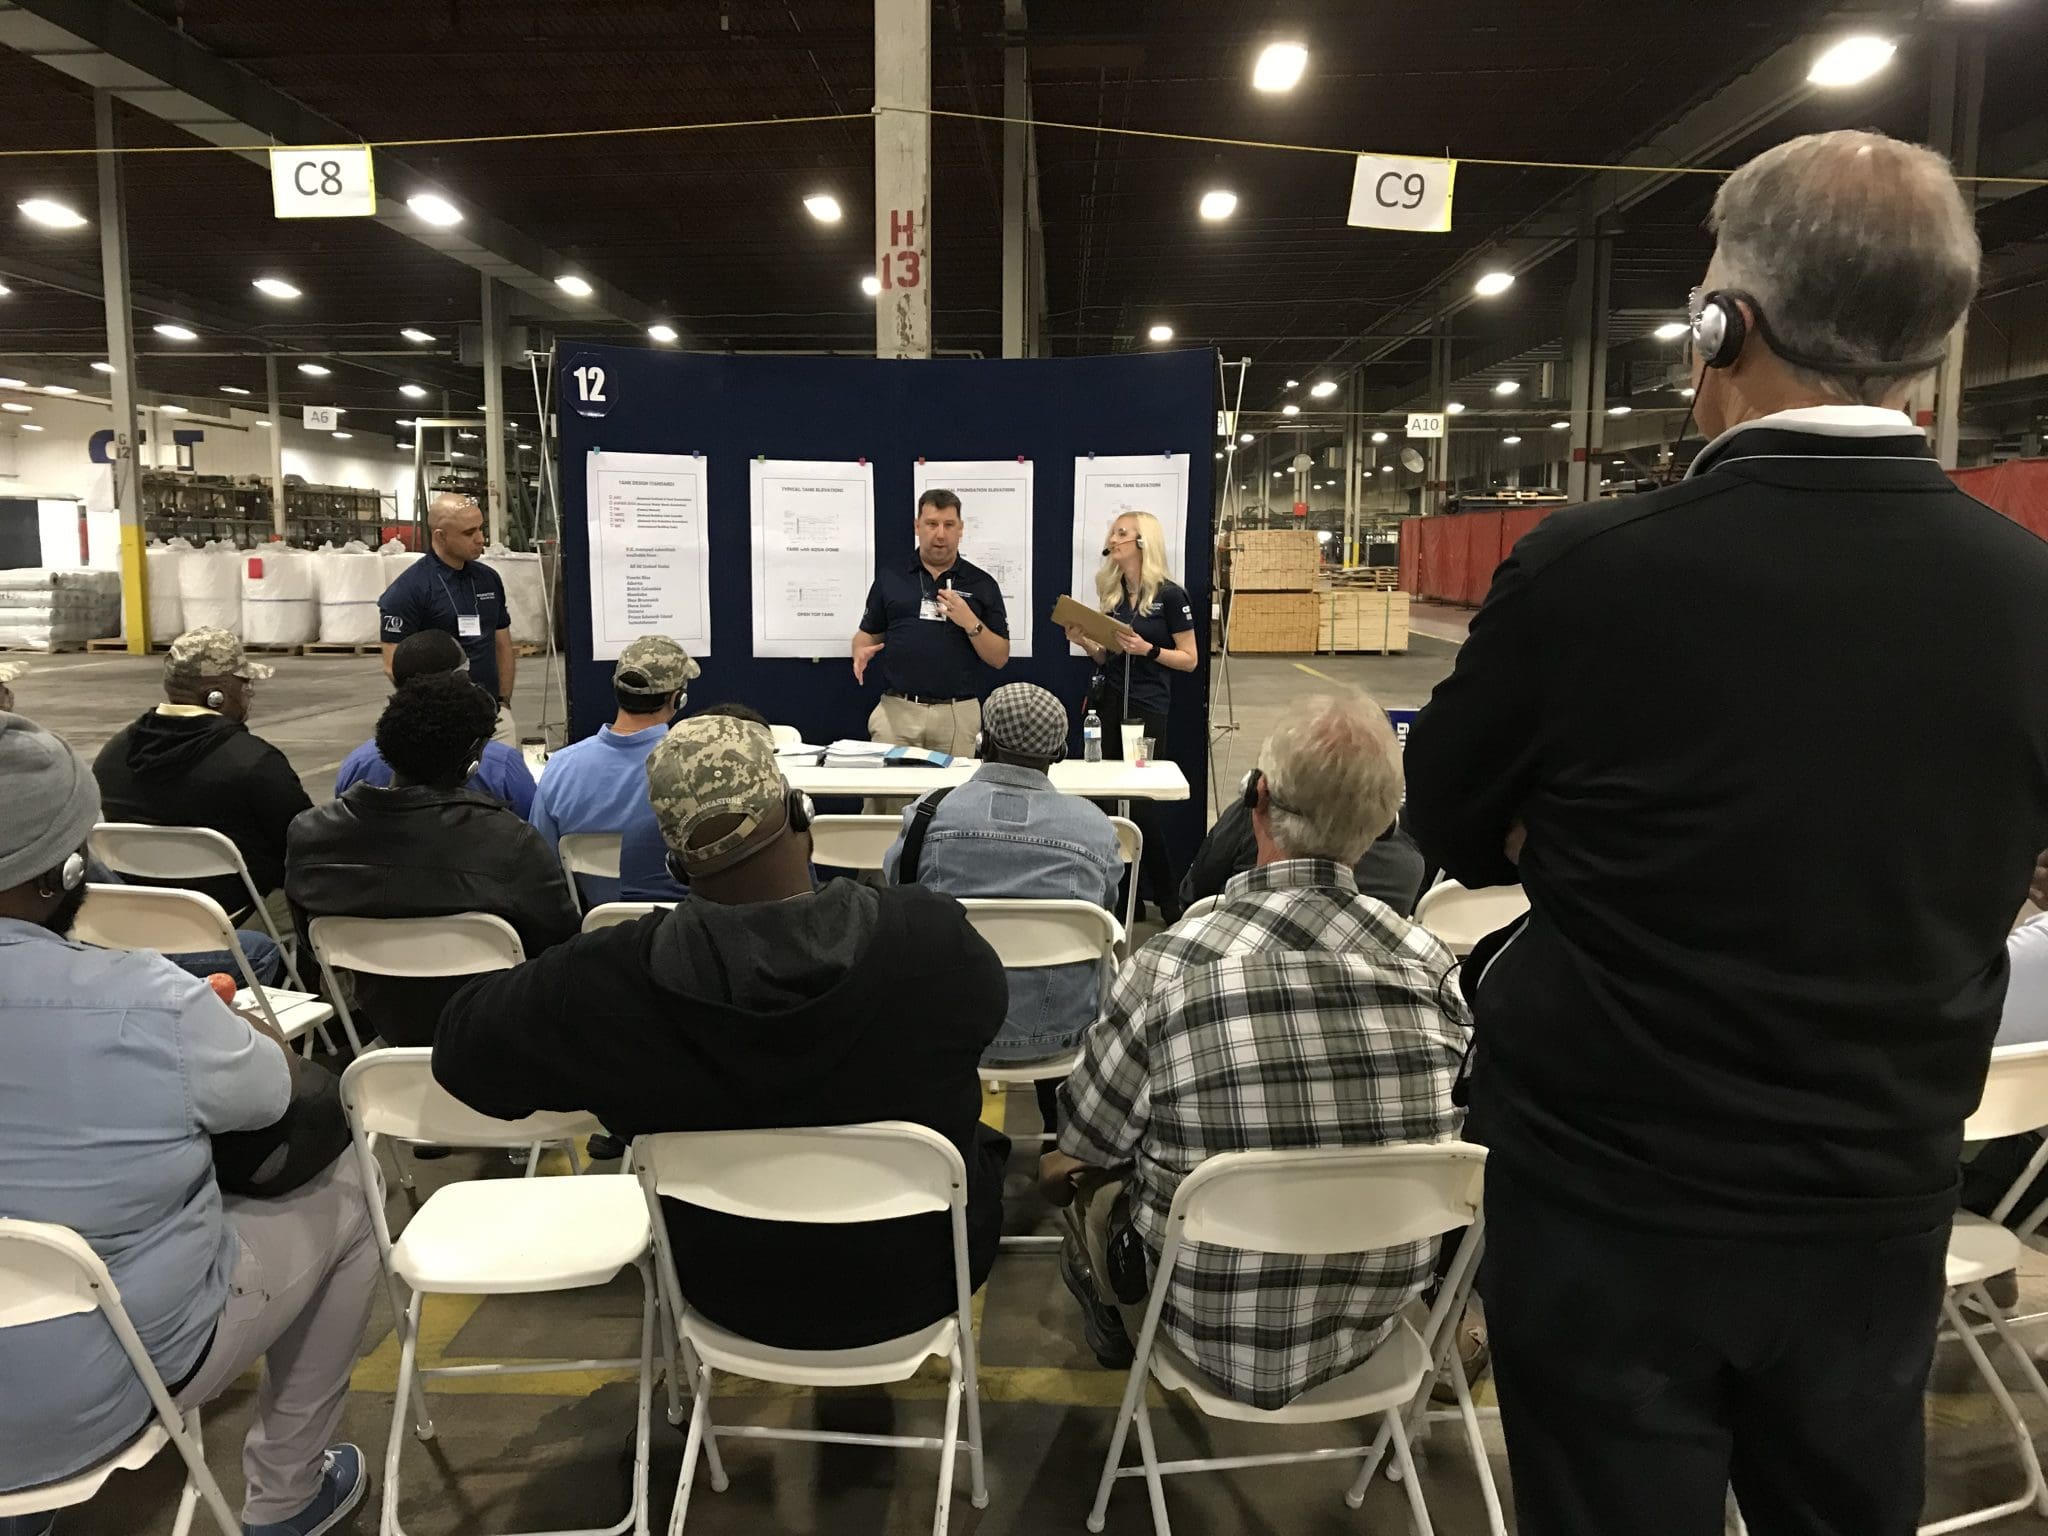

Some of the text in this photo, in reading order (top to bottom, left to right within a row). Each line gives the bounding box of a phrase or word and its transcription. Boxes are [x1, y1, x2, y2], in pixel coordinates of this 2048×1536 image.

[294, 161, 343, 196] C8
[1376, 171, 1425, 209] C9
[890, 210, 914, 246] H
[882, 251, 920, 290] 13
[573, 366, 607, 402] 12
[311, 411, 329, 424] A6
[1411, 418, 1439, 431] A10
